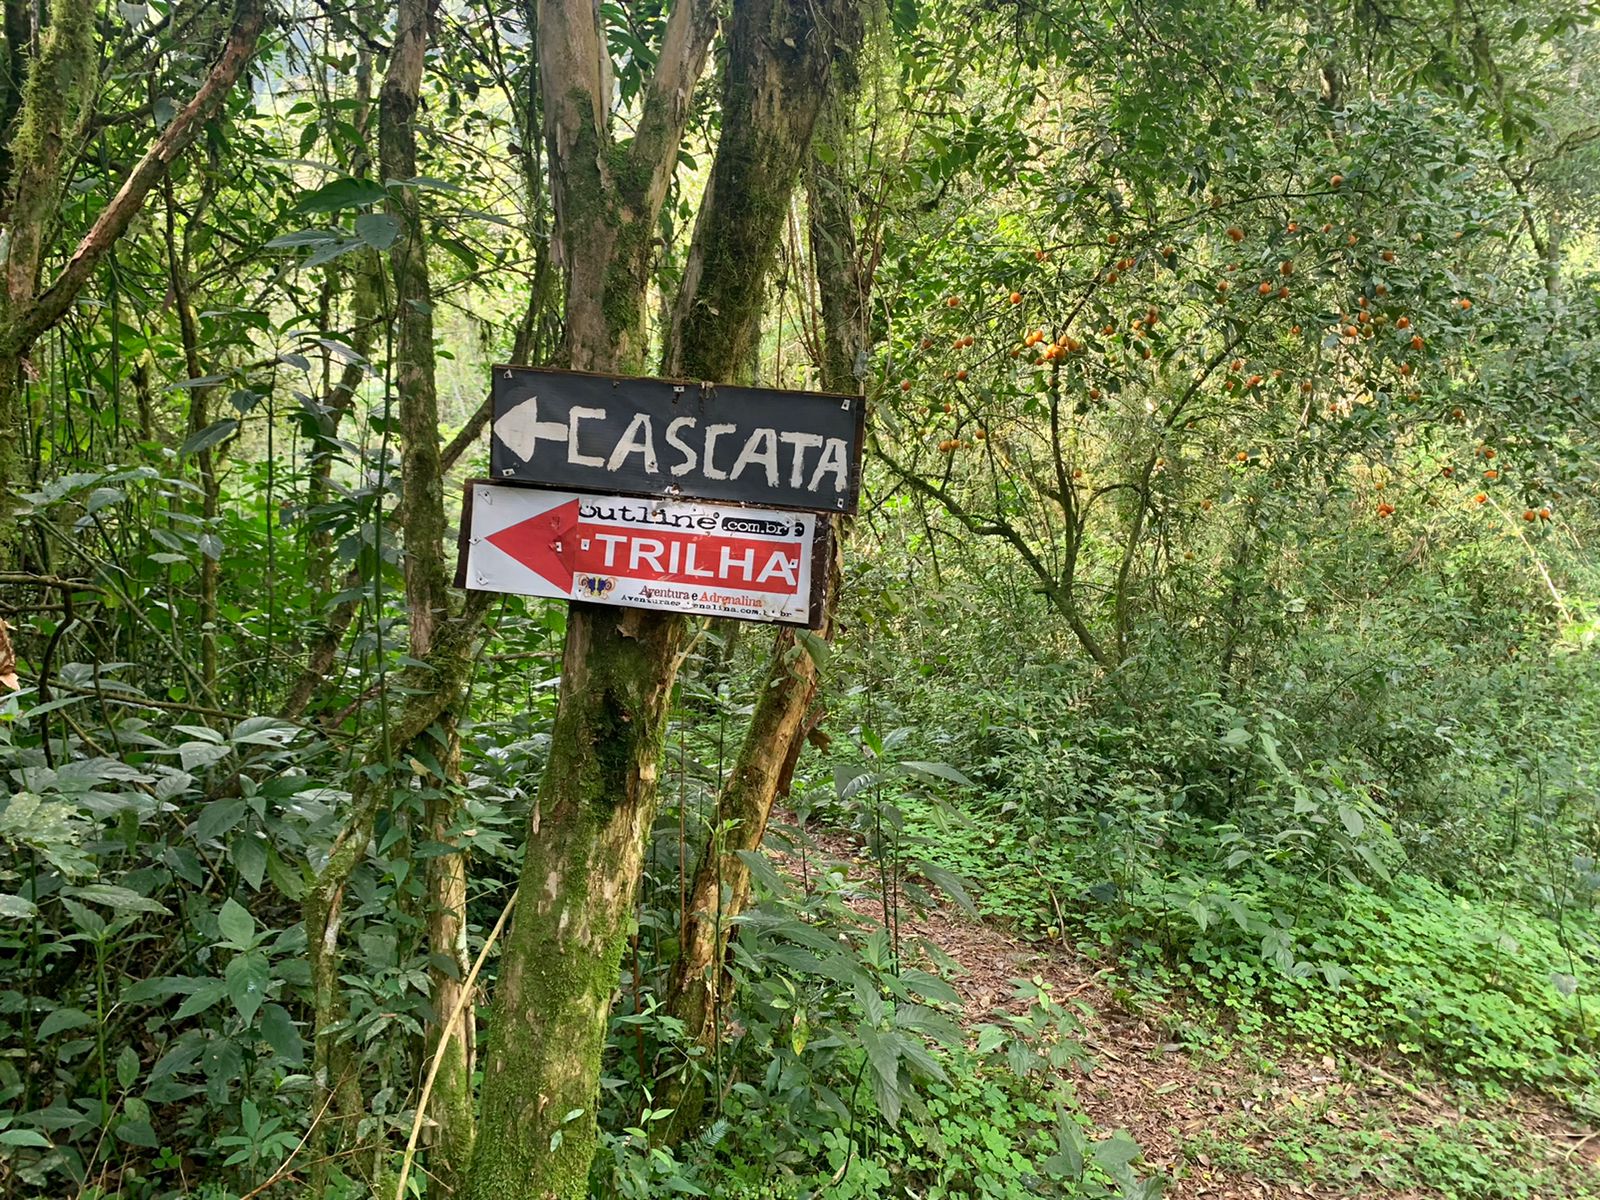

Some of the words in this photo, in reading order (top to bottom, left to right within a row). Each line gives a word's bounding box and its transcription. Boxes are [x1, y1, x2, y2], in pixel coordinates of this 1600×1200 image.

[567, 406, 848, 493] CASCATA
[596, 533, 797, 586] TRILHA
[638, 585, 690, 601] Aventura
[691, 593, 698, 601] e
[700, 591, 763, 608] Adrenalina
